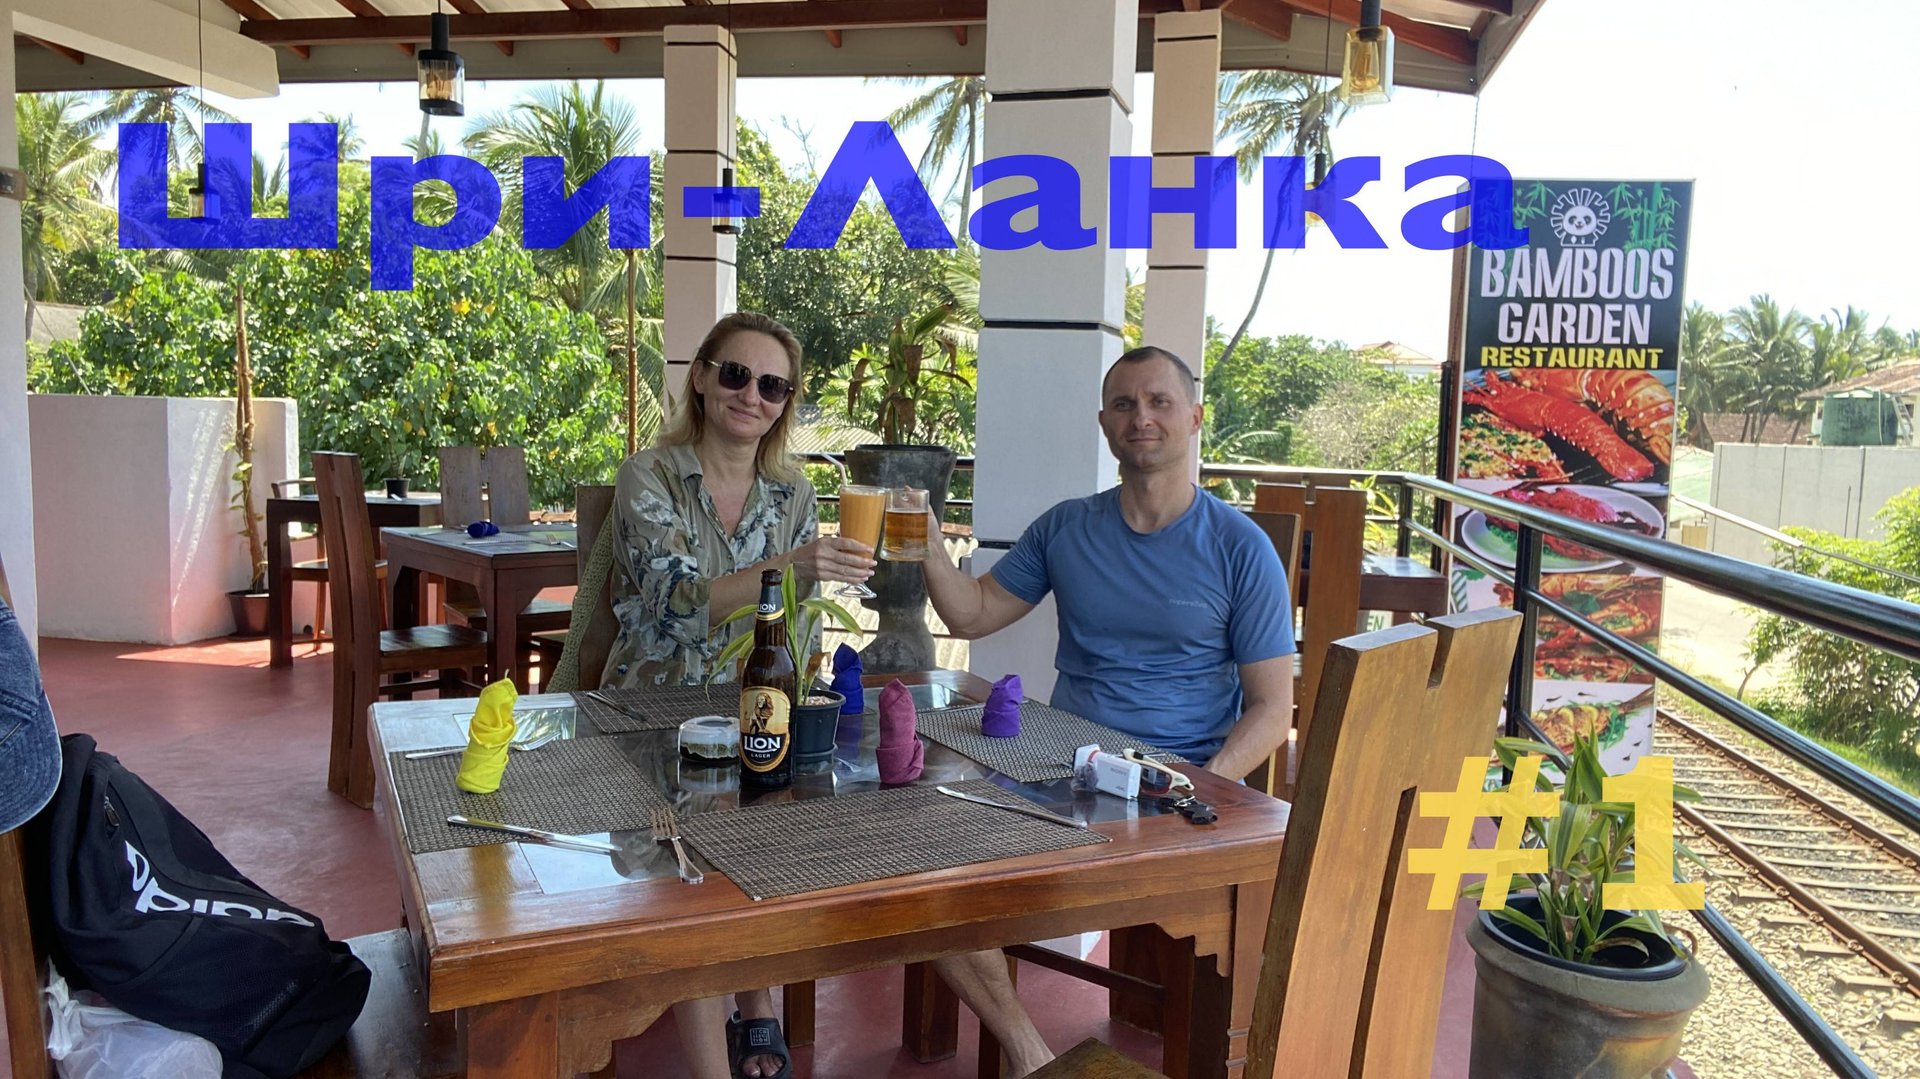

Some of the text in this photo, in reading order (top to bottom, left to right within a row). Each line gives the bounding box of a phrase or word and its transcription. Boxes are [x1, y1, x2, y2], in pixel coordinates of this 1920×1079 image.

[1480, 247, 1675, 299] BAMBOOS
[1498, 303, 1651, 345] GARDEN
[1480, 346, 1664, 369] RESTAURANT
[744, 735, 781, 753] LION
